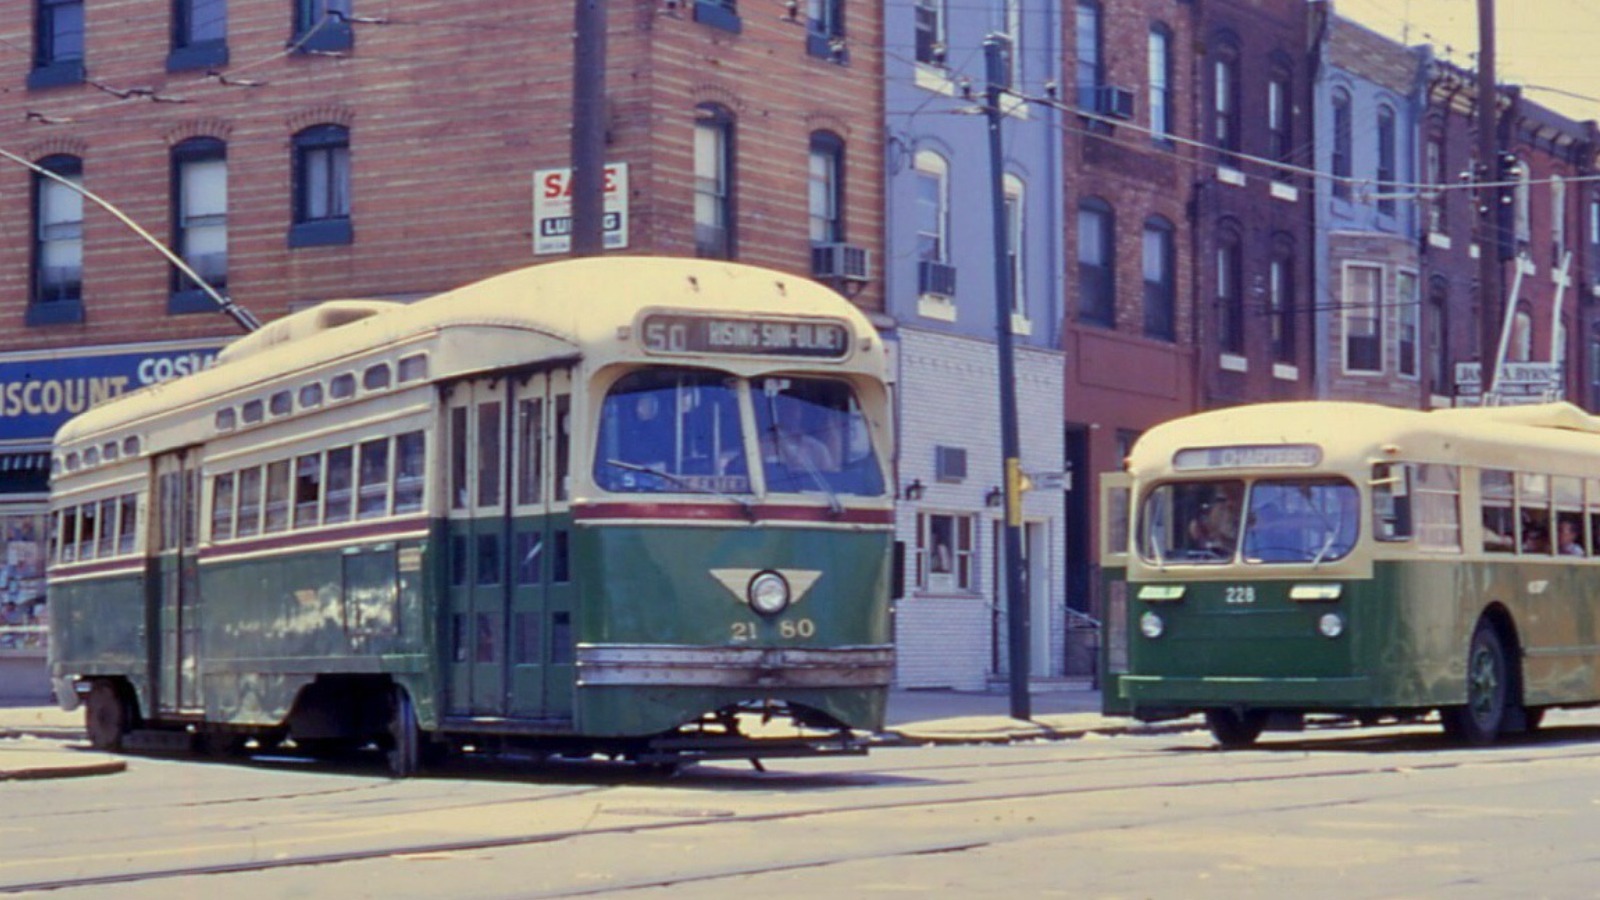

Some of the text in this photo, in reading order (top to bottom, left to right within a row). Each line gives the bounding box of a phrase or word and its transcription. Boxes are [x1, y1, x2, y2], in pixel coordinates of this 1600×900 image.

[544, 168, 617, 198] SE
[647, 324, 687, 351] 50
[708, 321, 758, 346] RISING
[731, 618, 814, 641] 21 80
